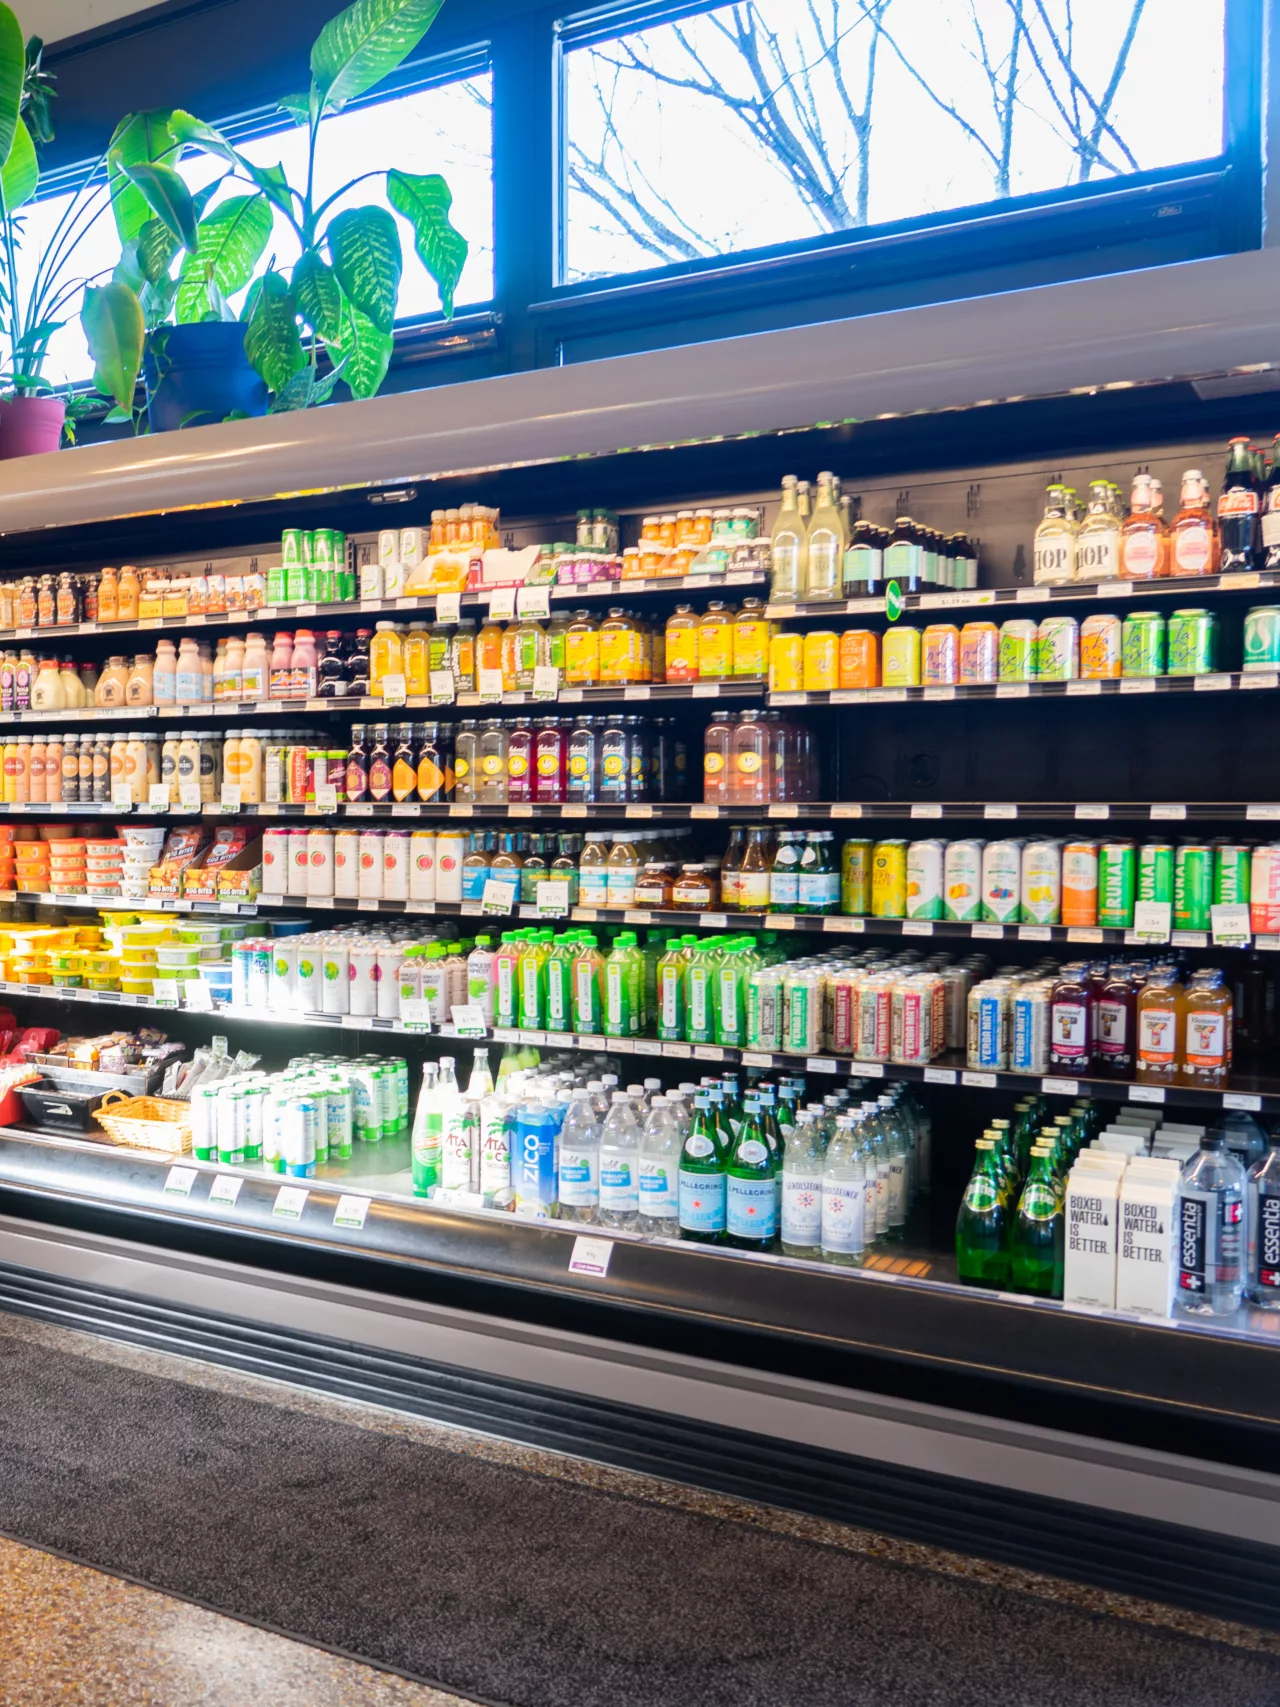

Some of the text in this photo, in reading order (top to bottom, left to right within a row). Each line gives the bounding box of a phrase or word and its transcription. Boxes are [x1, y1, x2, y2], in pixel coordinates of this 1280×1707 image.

[1106, 865, 1121, 908] RUNA
[793, 991, 802, 1045] YERBA MATE
[837, 989, 846, 1044] YERBA MATE
[878, 997, 886, 1053] YERBA MATE
[905, 999, 915, 1056] YERBA MATE
[982, 1003, 991, 1061] YERBA MATE
[1016, 1005, 1025, 1063] YERBA MATE
[523, 1134, 540, 1184] ZICO
[729, 1185, 775, 1198] .PELLEGRINO
[821, 1185, 859, 1200] EROLSTEINER
[1070, 1195, 1102, 1211] BOXED
[1070, 1210, 1103, 1226] WATER
[1124, 1203, 1157, 1219] BOXED
[1124, 1217, 1158, 1234] WATER
[1070, 1224, 1079, 1237] IS
[1123, 1231, 1133, 1245] IS
[1182, 1201, 1198, 1268] essentia
[1264, 1198, 1280, 1265] essentia
[1070, 1237, 1110, 1255] BETTER.
[1123, 1246, 1165, 1263] BETTER.
